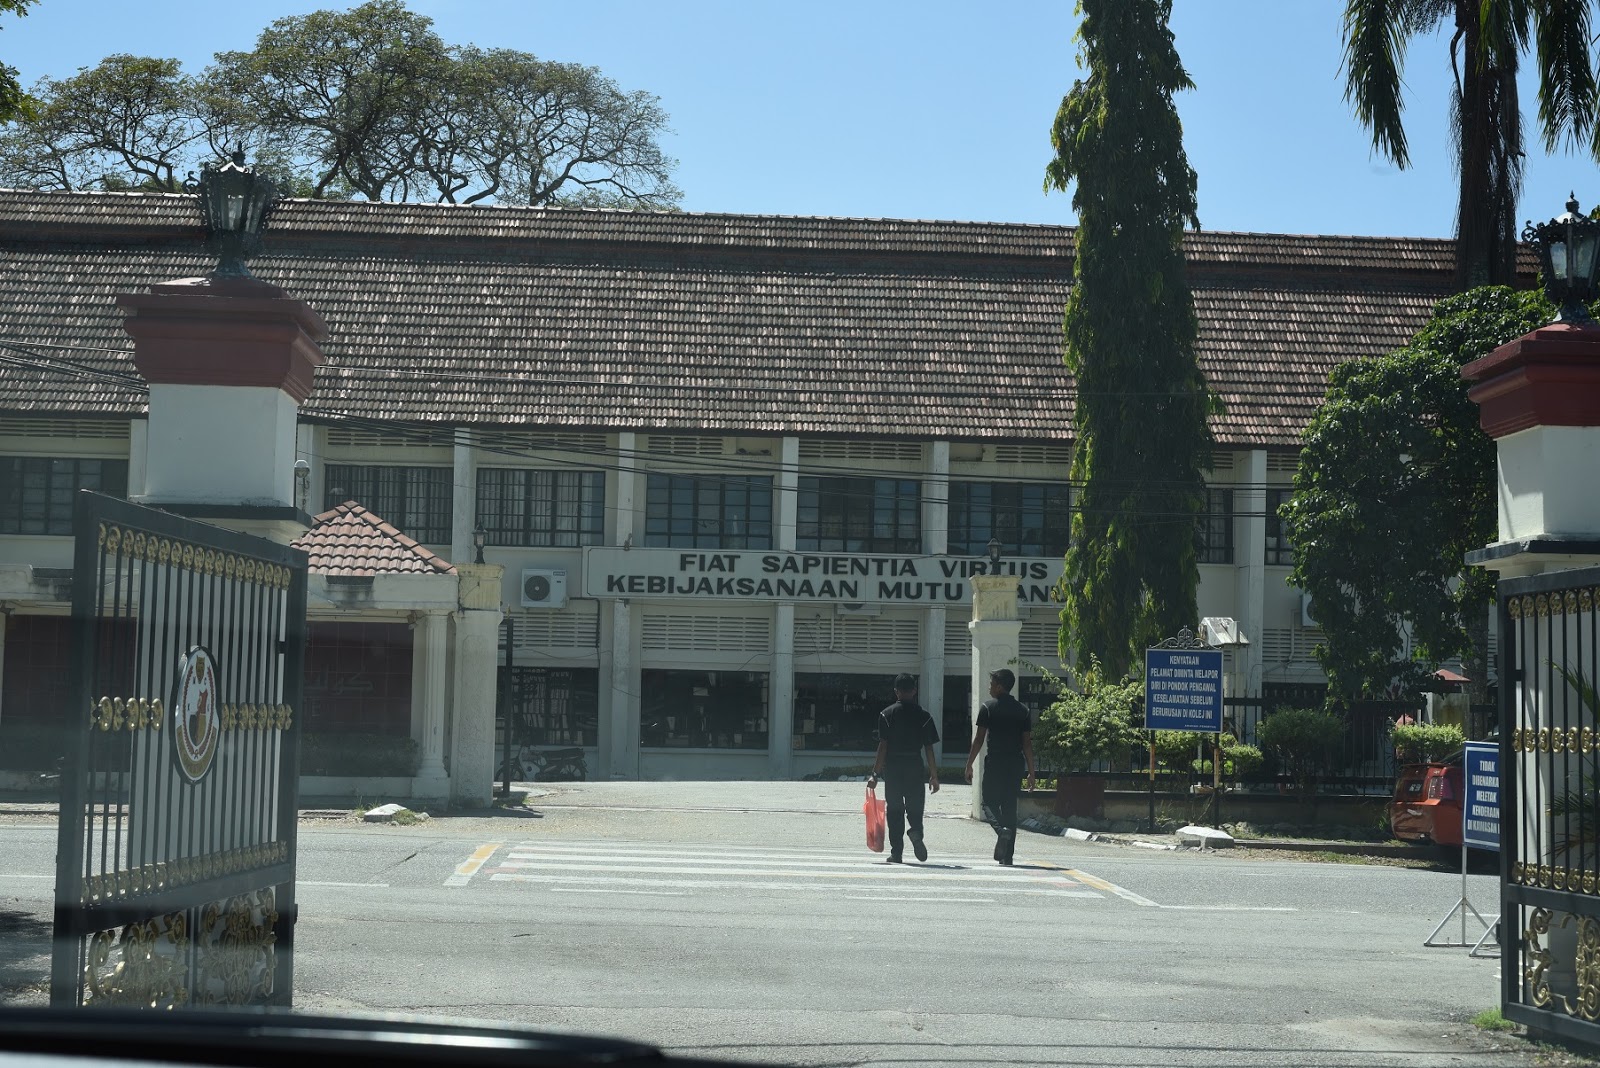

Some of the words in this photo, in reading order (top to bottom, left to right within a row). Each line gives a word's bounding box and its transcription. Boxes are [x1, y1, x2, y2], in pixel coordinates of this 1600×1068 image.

[680, 553, 741, 573] FIAT
[762, 555, 918, 577] SAPIENTIA
[607, 574, 858, 599] KEBIJAKSANAAN
[877, 580, 963, 601] MUTU
[1170, 655, 1199, 665] KENYATAAN
[1195, 670, 1218, 678] MELAPOR
[1168, 682, 1188, 691] PONDOK
[1189, 683, 1216, 692] PENGAWAL
[1153, 694, 1189, 704] KESELAMATAN
[1190, 696, 1213, 705] SEBELUM
[1152, 707, 1181, 717] BERURUSAN
[1189, 709, 1204, 718] KOLEJ
[1480, 760, 1495, 772] TIDAK
[1472, 775, 1499, 787] DIBENARKA
[1476, 790, 1496, 802] MELETAK
[1472, 804, 1500, 818] KENDERAAN
[1468, 819, 1472, 830] DI
